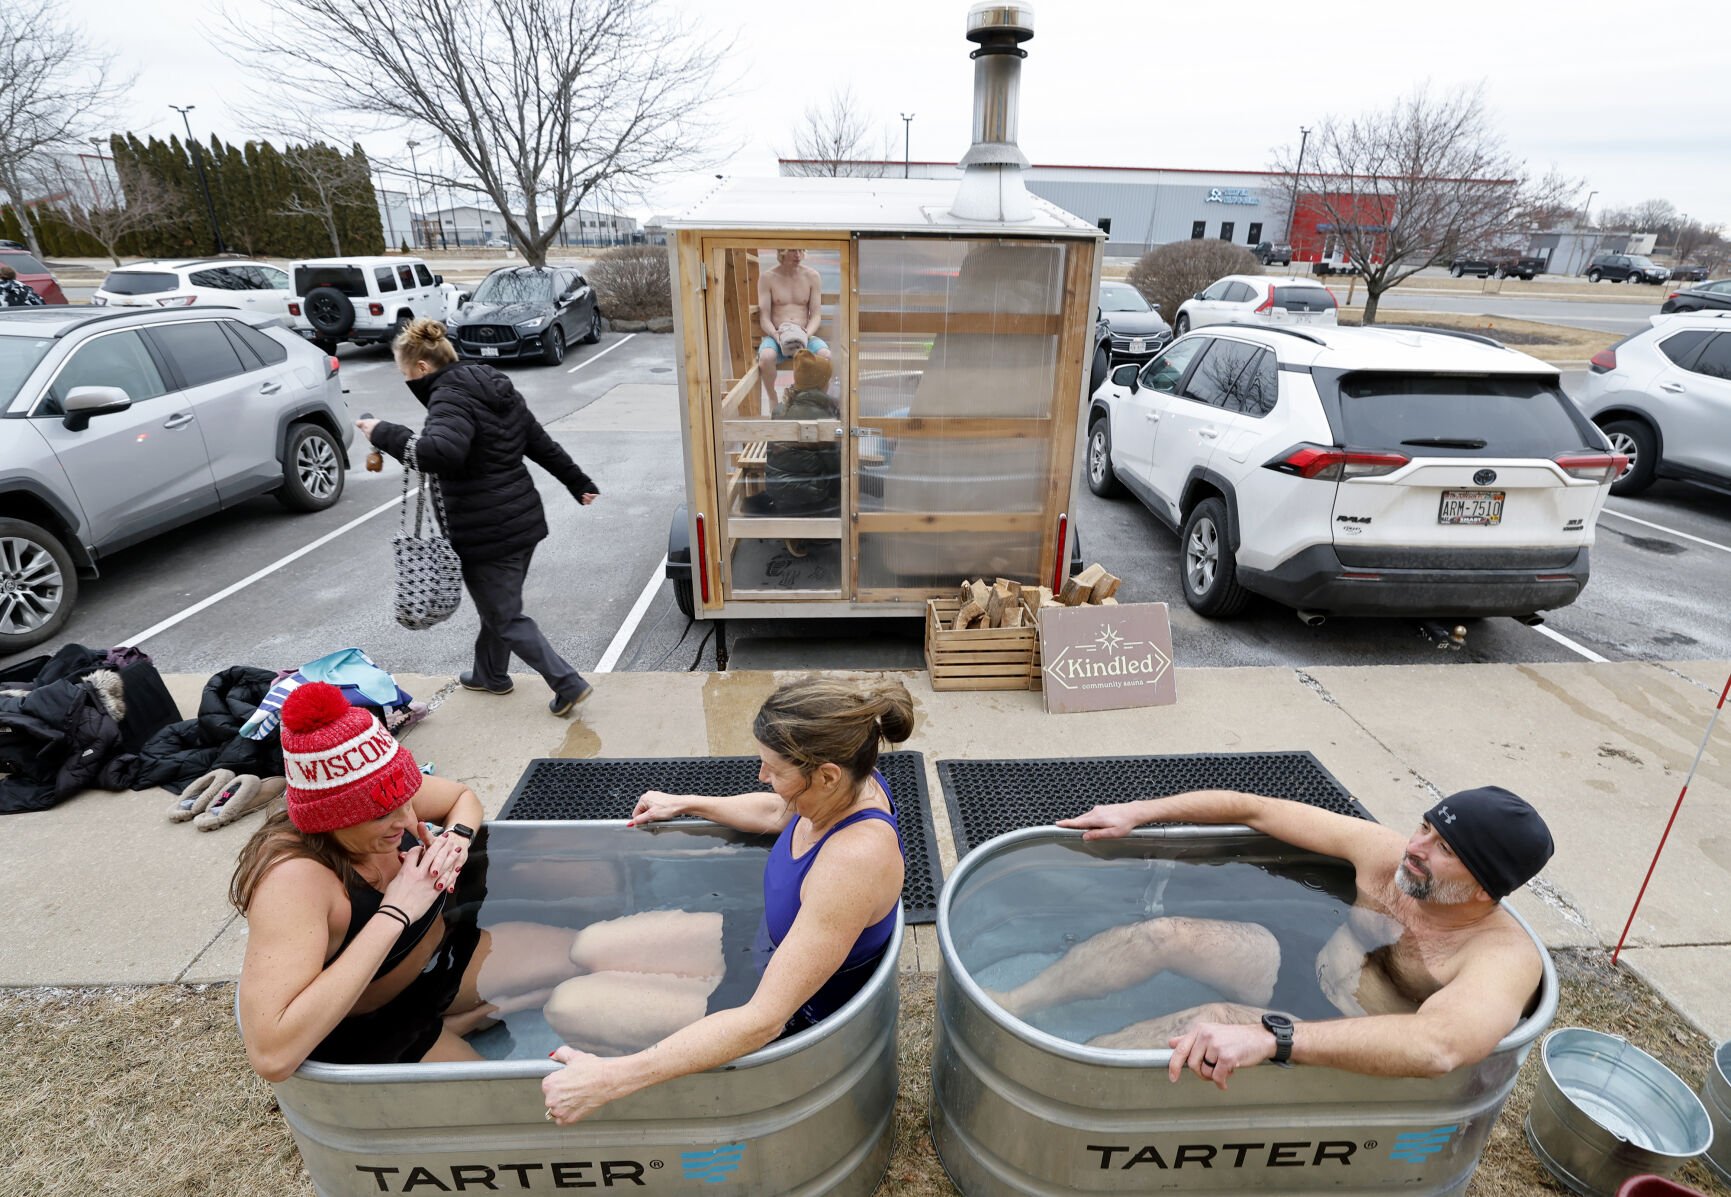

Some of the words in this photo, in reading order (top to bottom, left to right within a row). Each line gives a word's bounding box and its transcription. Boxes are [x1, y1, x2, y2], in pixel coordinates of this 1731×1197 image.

[1442, 500, 1501, 517] ARM-7510
[1067, 654, 1153, 678] Kindled
[1081, 680, 1122, 690] community
[1123, 679, 1144, 688] sauna
